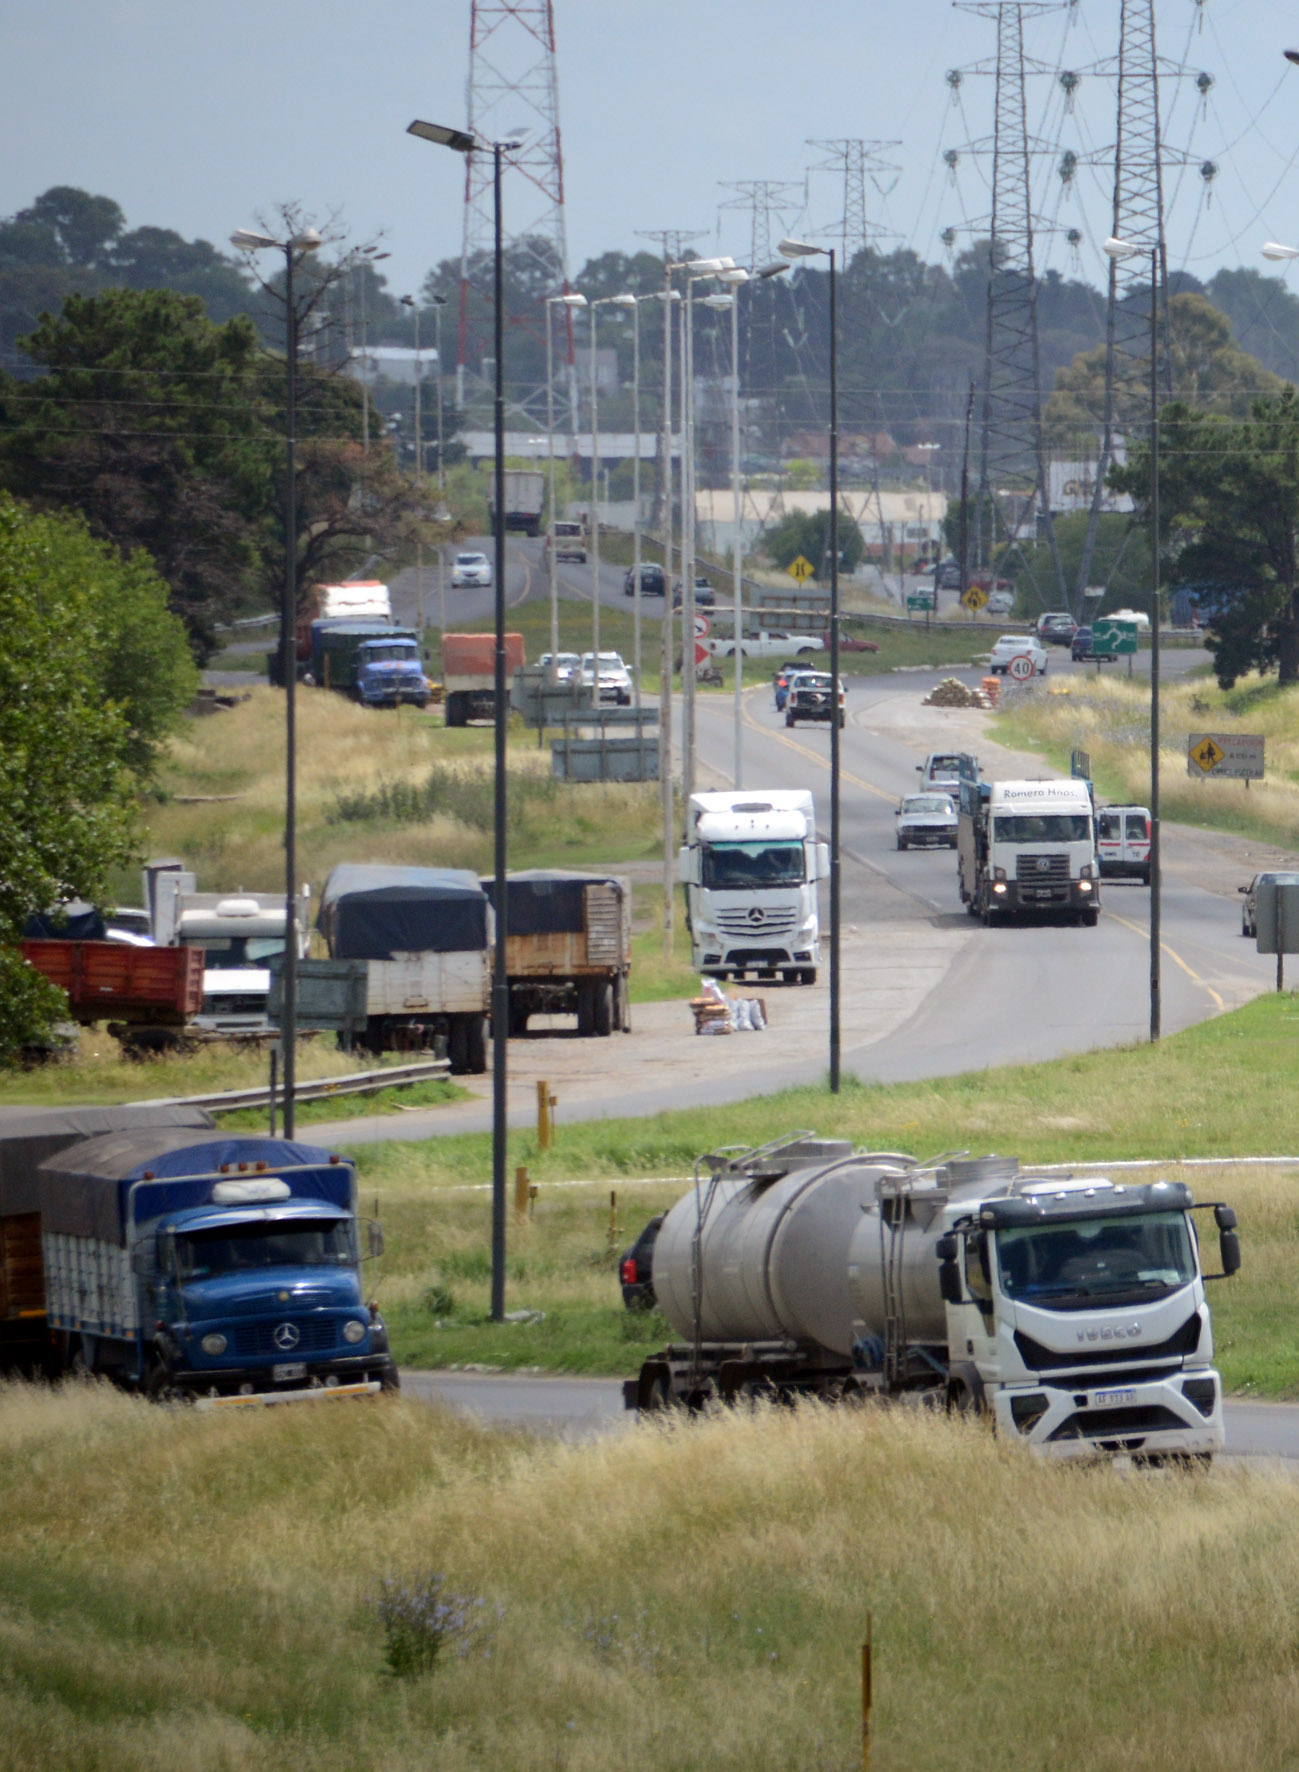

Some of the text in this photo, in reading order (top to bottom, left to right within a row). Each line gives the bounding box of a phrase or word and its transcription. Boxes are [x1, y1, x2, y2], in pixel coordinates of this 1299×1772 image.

[1014, 662, 1030, 675] 40
[1003, 789, 1044, 799] Romero
[1076, 1321, 1142, 1342] IVECO
